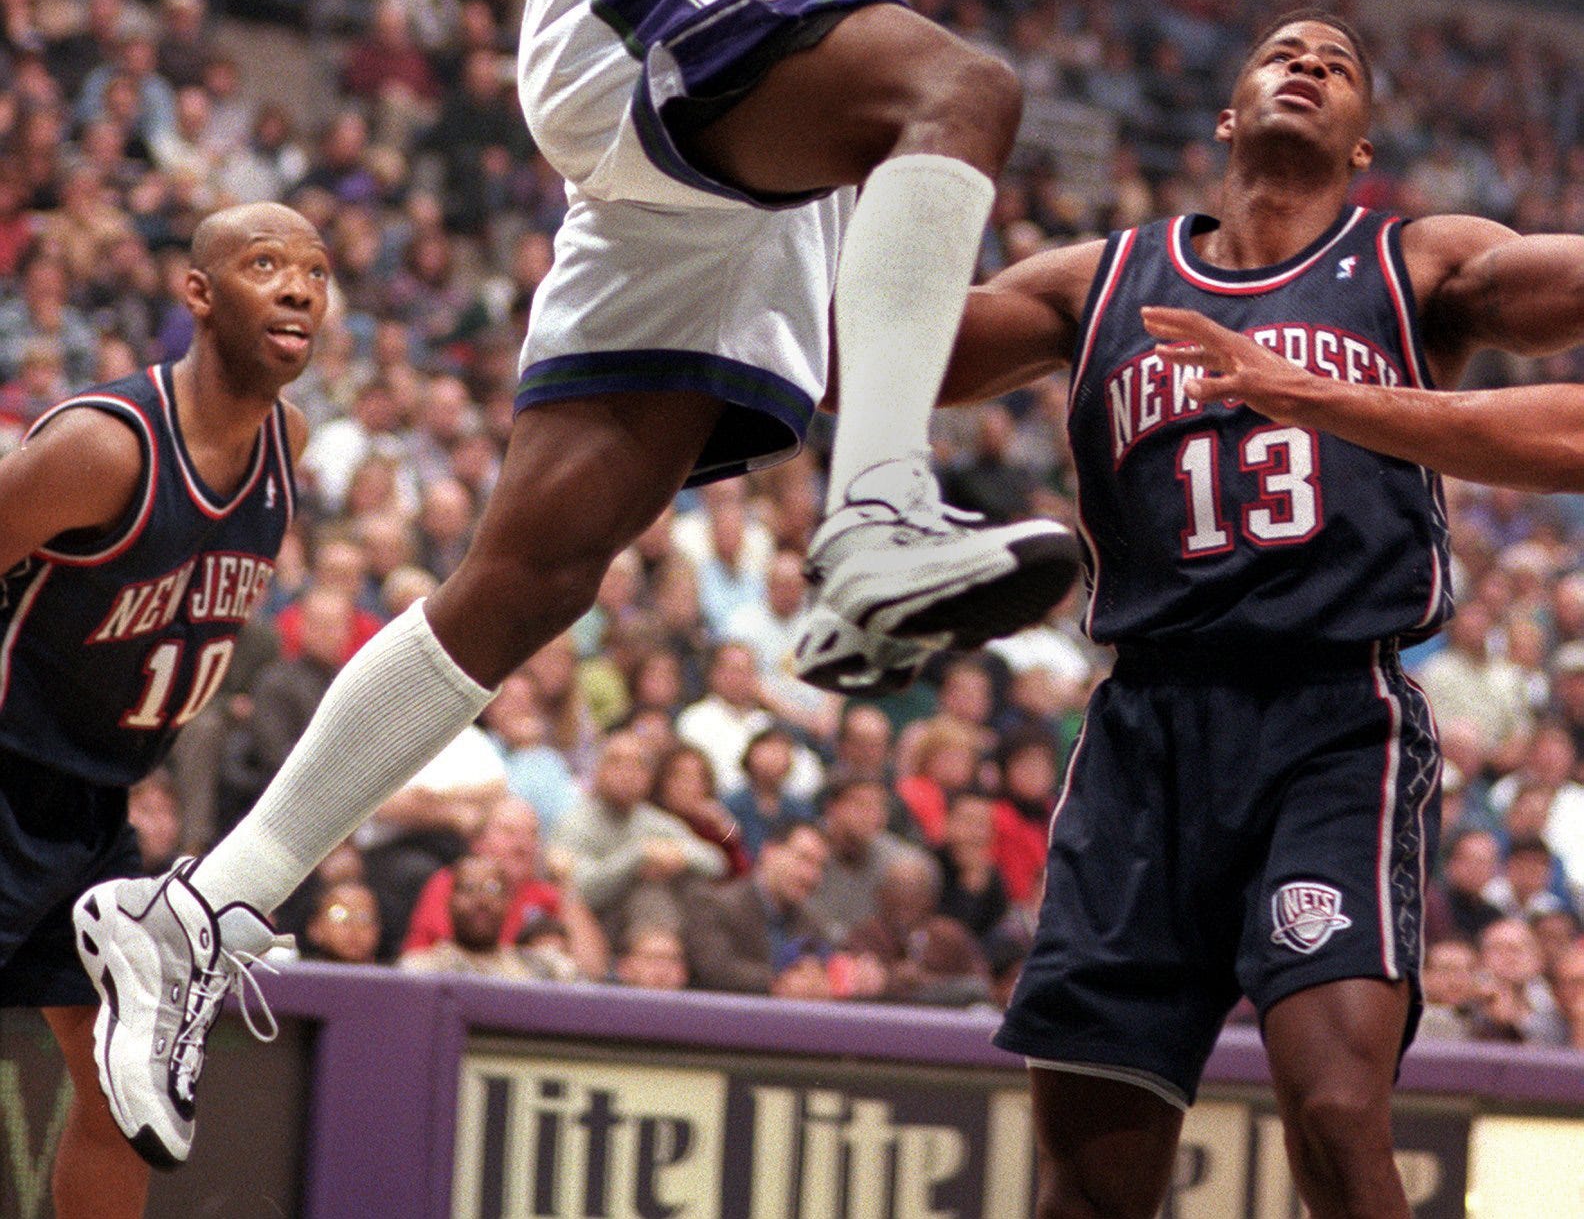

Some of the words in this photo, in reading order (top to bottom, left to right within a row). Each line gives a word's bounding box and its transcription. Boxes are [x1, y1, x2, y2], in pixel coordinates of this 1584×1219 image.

[1106, 342, 1206, 466] NEW
[1175, 424, 1324, 559] 13
[119, 636, 237, 727] 10
[1282, 888, 1337, 922] NETS
[480, 1075, 698, 1219] lite
[750, 1085, 970, 1219] lite
